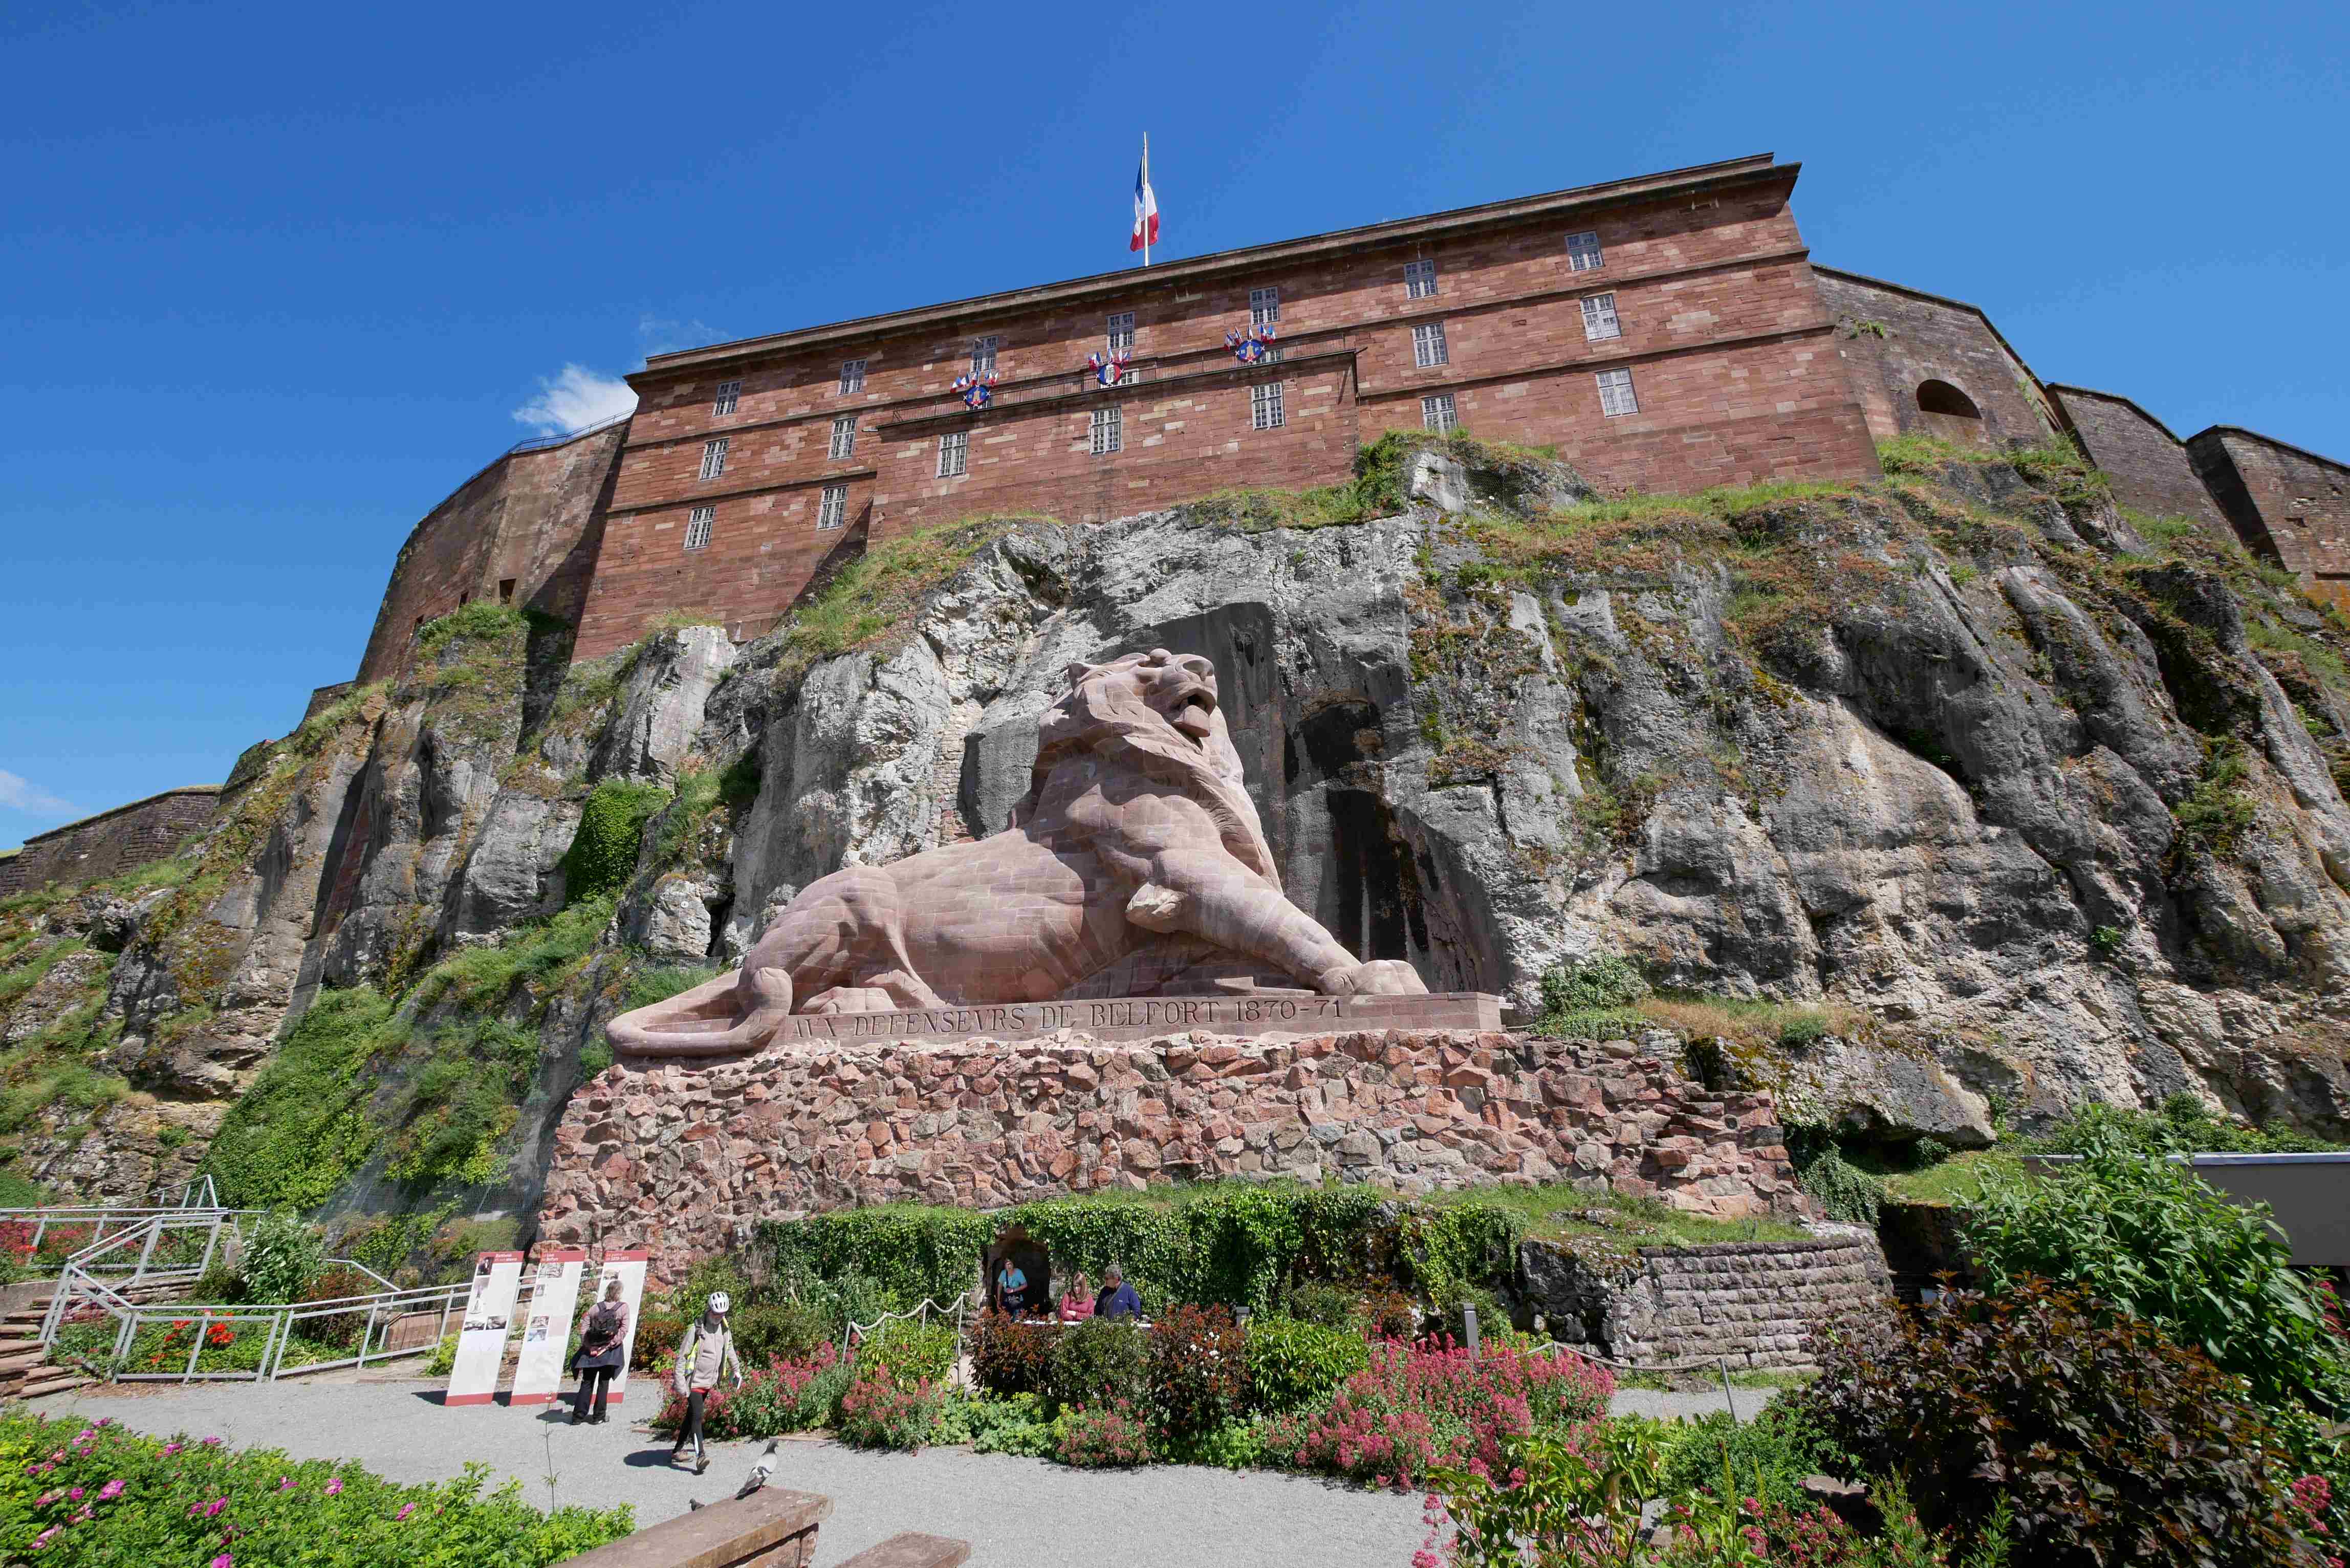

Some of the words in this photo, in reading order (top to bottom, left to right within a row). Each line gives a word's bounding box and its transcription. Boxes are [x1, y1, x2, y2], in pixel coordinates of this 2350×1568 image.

[1039, 1005, 1077, 1030] DE
[1089, 1000, 1221, 1027] BELFORT
[1235, 999, 1343, 1022] 1870-71
